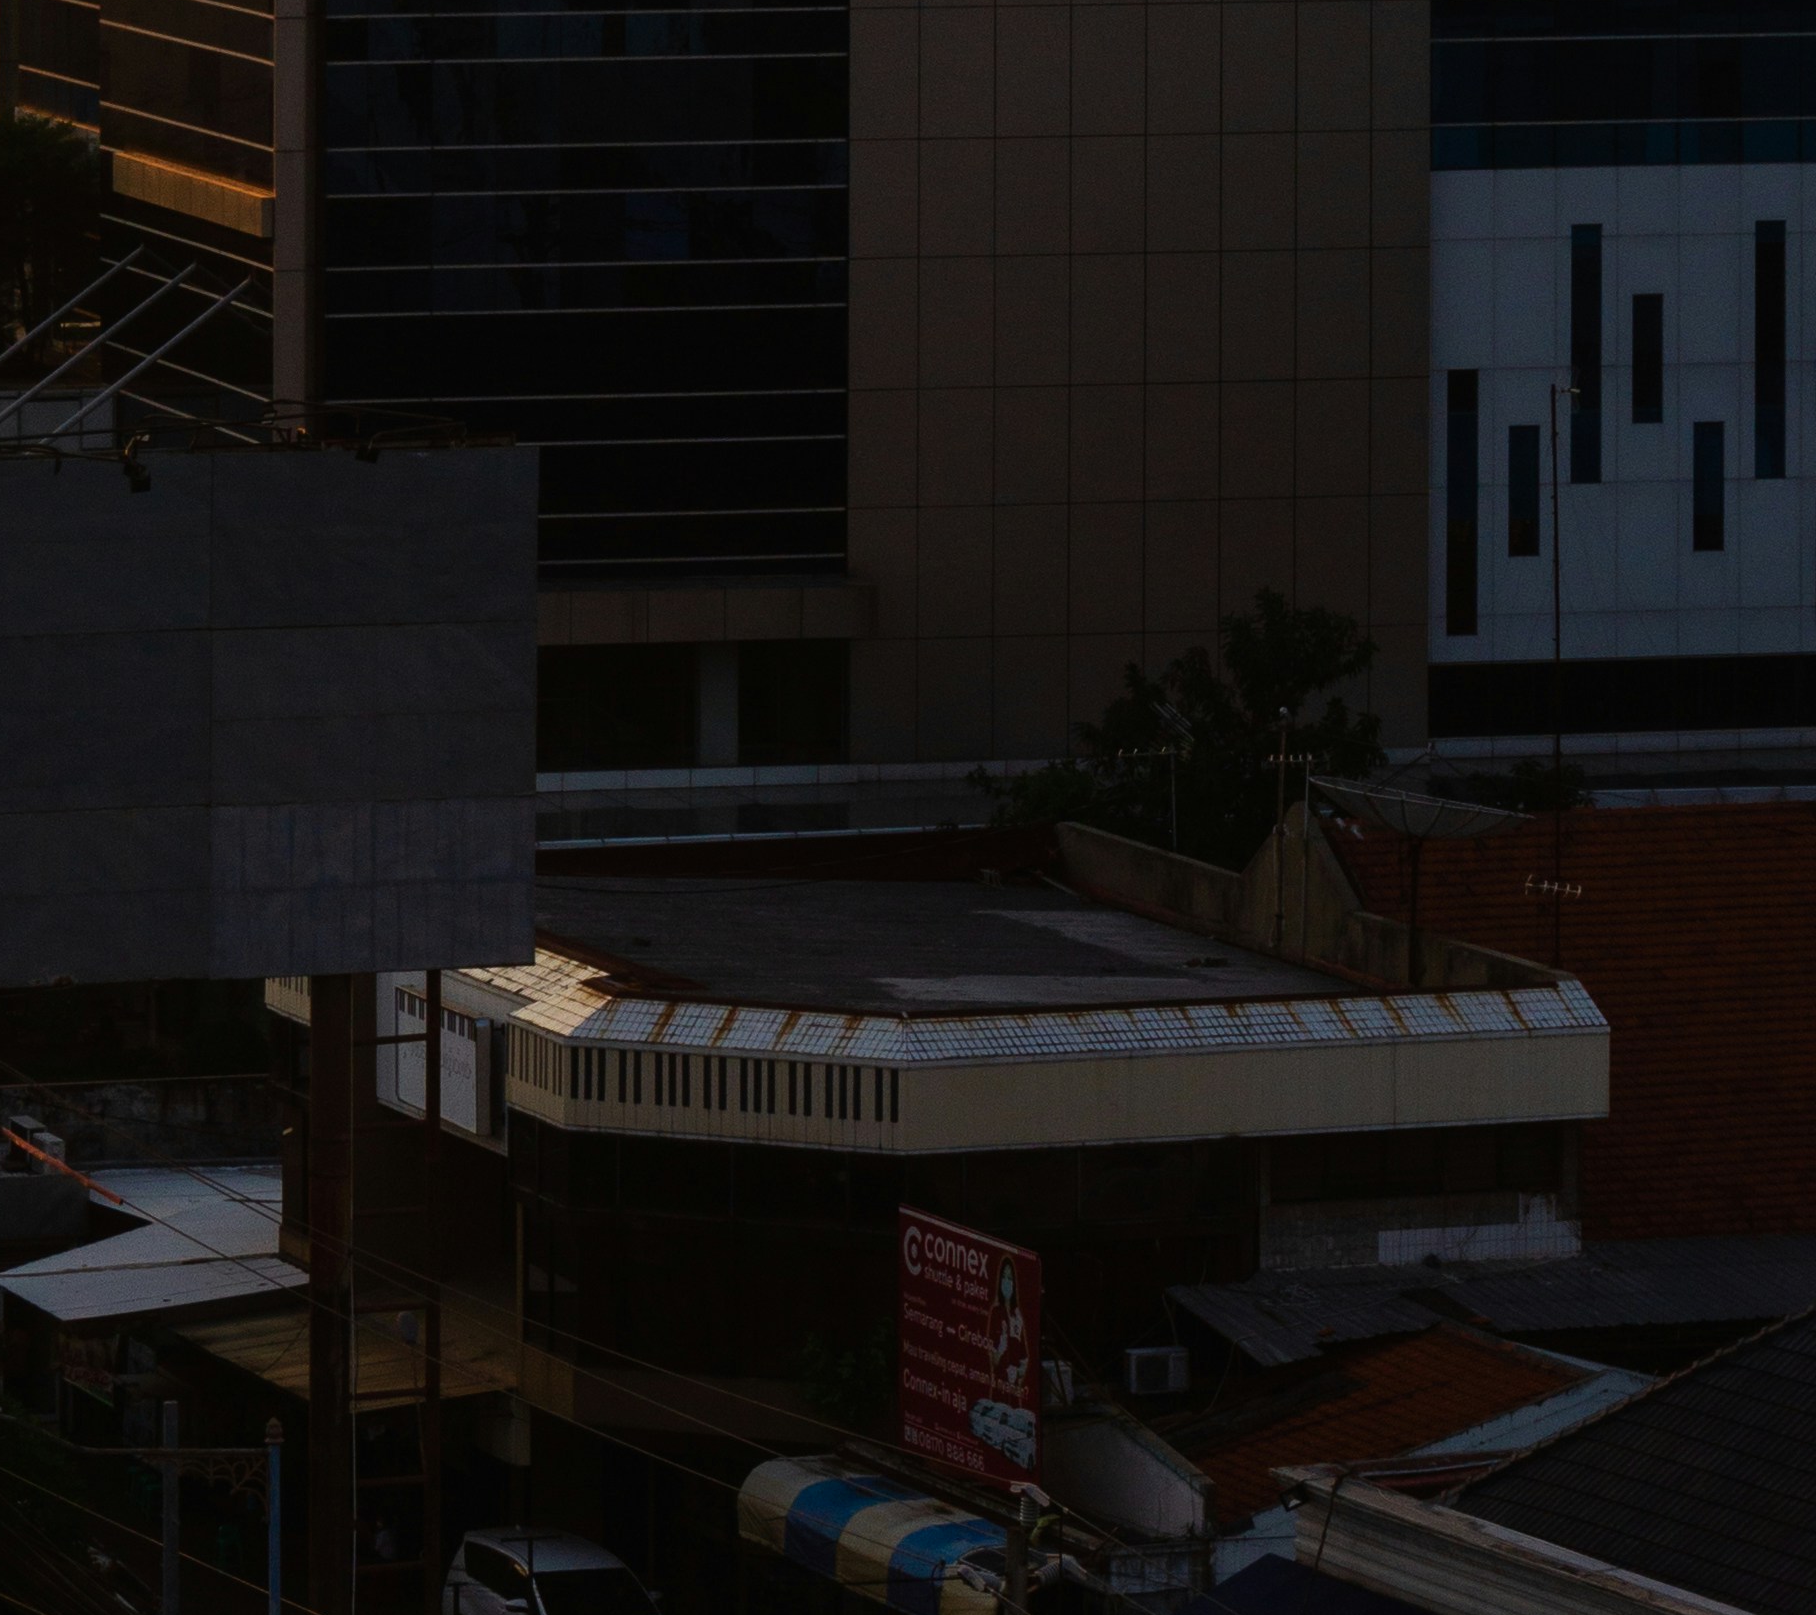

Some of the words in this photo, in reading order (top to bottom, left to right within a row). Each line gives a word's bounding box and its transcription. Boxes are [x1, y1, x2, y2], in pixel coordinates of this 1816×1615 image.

[924, 1232, 989, 1280] connex
[955, 1273, 963, 1292] &
[964, 1279, 989, 1302] paket
[903, 1302, 944, 1339] Semarang
